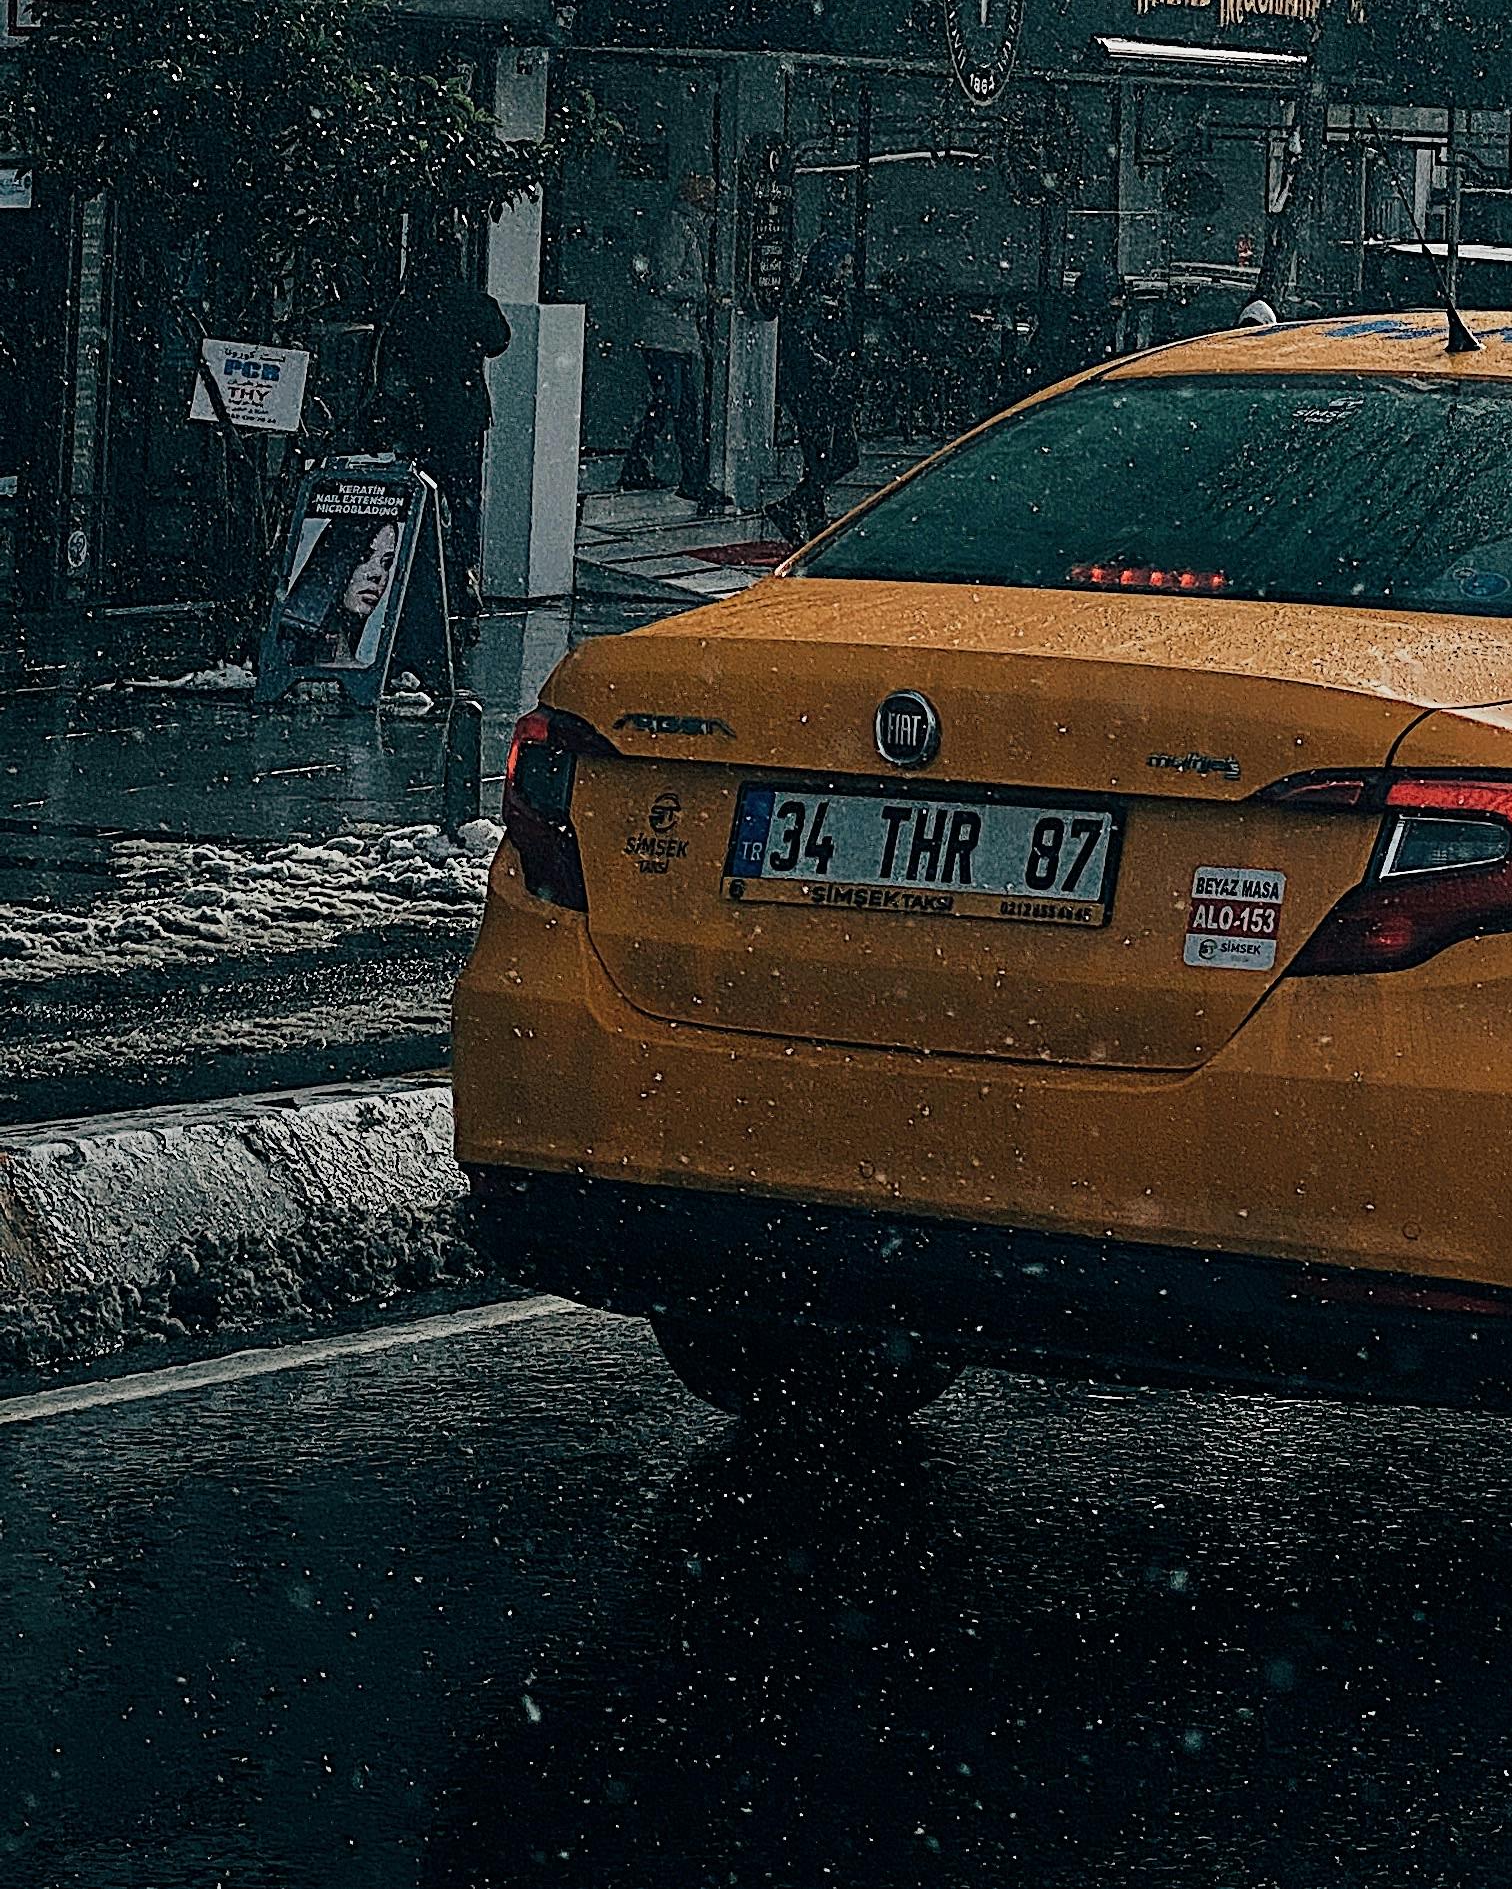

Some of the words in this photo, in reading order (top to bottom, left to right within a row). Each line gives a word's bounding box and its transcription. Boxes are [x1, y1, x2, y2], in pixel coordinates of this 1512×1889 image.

[227, 386, 272, 402] THY
[315, 503, 399, 517] MICROBLADING
[342, 495, 404, 507] EXTENSION
[887, 712, 922, 747] FIAT
[742, 841, 763, 861] TR
[769, 800, 835, 875] 34
[879, 804, 982, 885] THR
[1025, 817, 1104, 893] 87
[1195, 876, 1240, 897] BEYAZ
[1241, 879, 1280, 900] MASA
[1192, 904, 1276, 933] ALO-153
